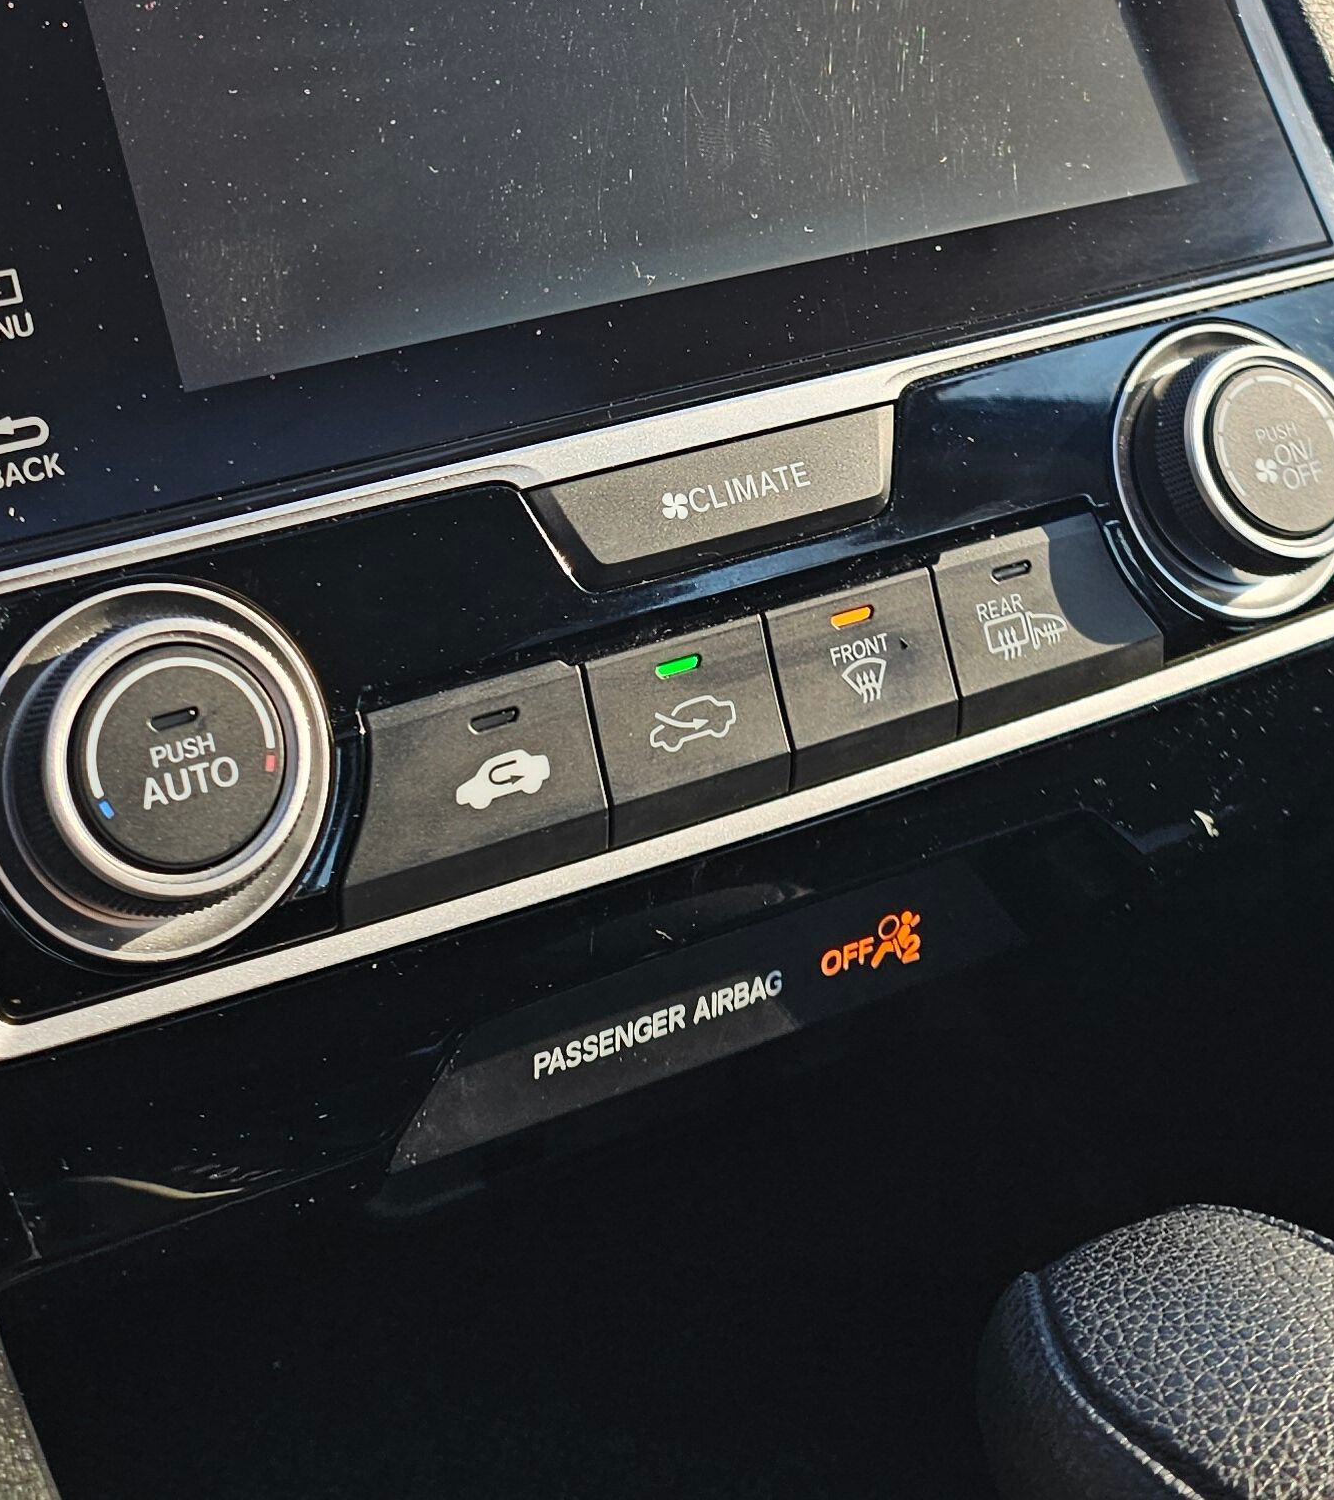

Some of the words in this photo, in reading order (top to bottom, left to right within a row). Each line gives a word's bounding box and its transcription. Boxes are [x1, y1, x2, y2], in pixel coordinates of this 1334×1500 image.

[1255, 420, 1299, 445] PUSH
[688, 461, 812, 514] CLIMATE
[1282, 460, 1323, 491] OFF
[976, 593, 1023, 623] REAR
[829, 632, 888, 666] FRONT
[149, 732, 217, 768] PUSH
[142, 756, 240, 811] AUTO
[532, 1003, 686, 1080] PASSENGER
[692, 969, 784, 1026] AIRBAG
[820, 935, 875, 977] OFF
